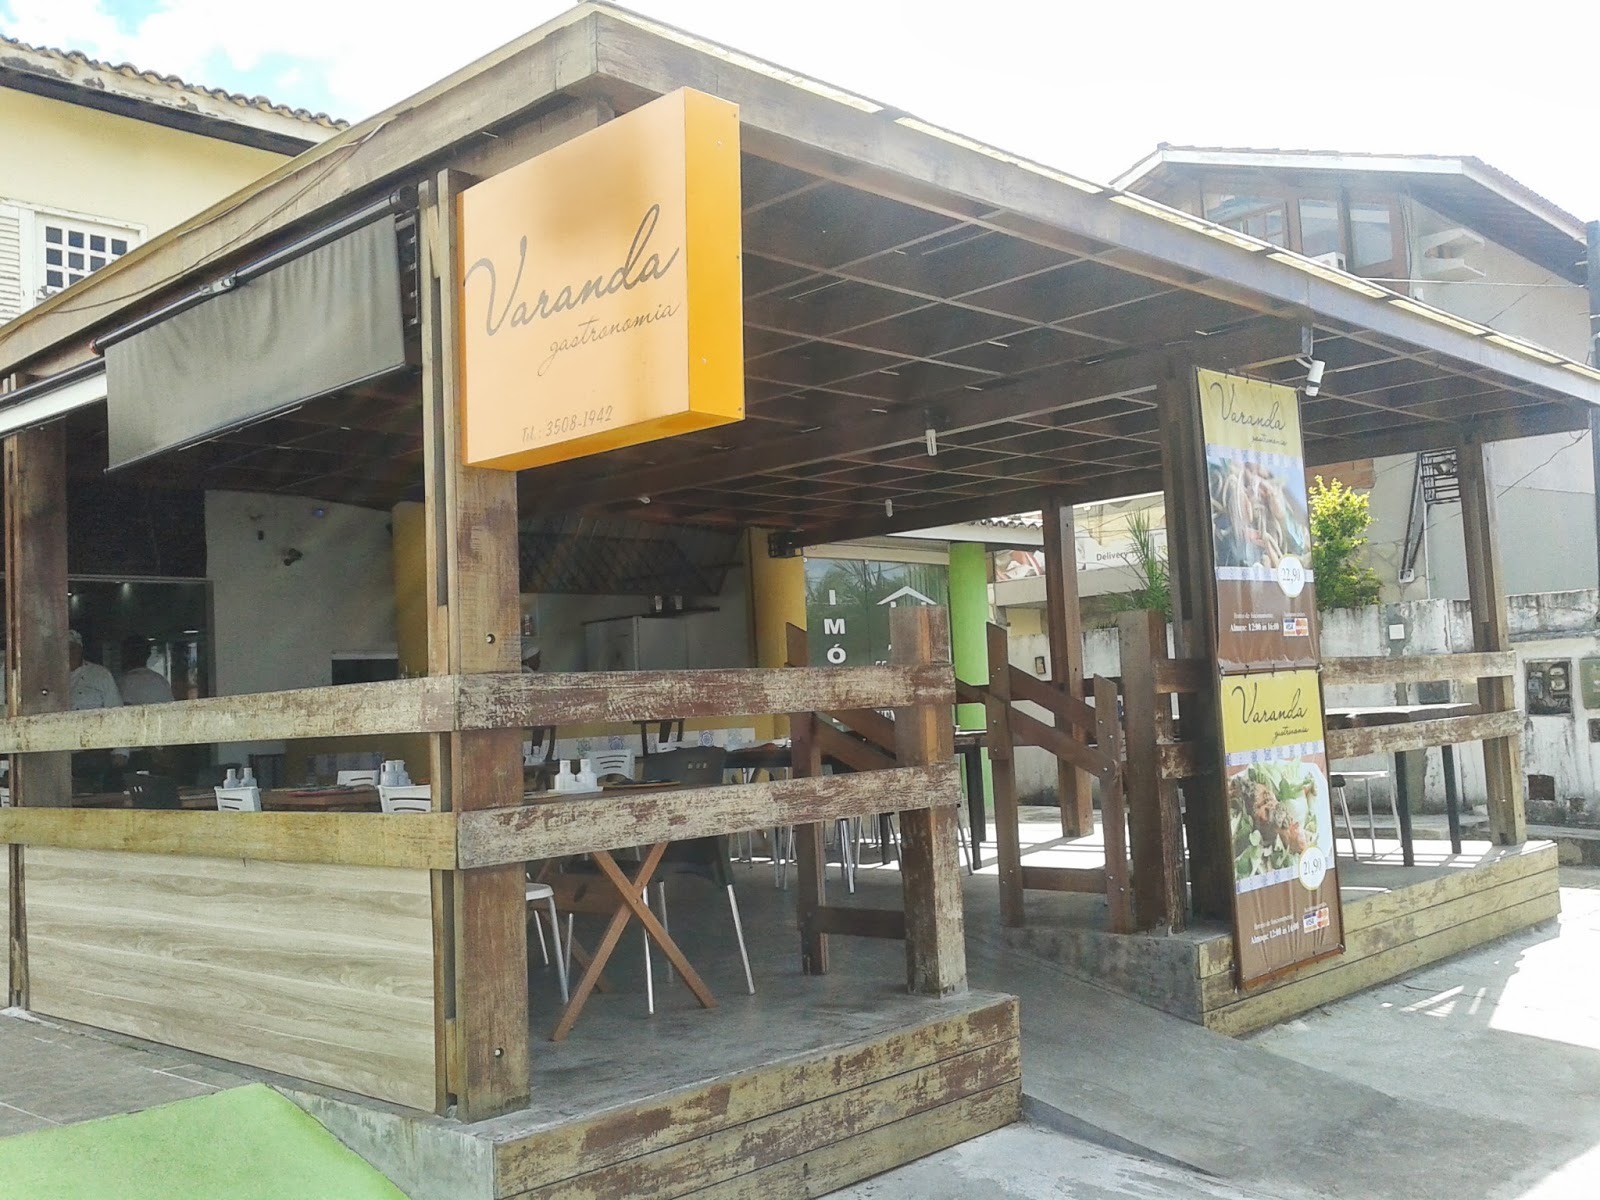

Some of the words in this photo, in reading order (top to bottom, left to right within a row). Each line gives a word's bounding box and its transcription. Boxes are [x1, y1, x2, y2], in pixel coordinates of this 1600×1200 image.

[464, 203, 680, 337] Varanda
[537, 302, 681, 377] gastronomia
[545, 405, 614, 437] 3508-1942
[1209, 382, 1286, 431] Varanda
[1095, 551, 1128, 562] Delivery
[1231, 682, 1308, 724] Varanda
